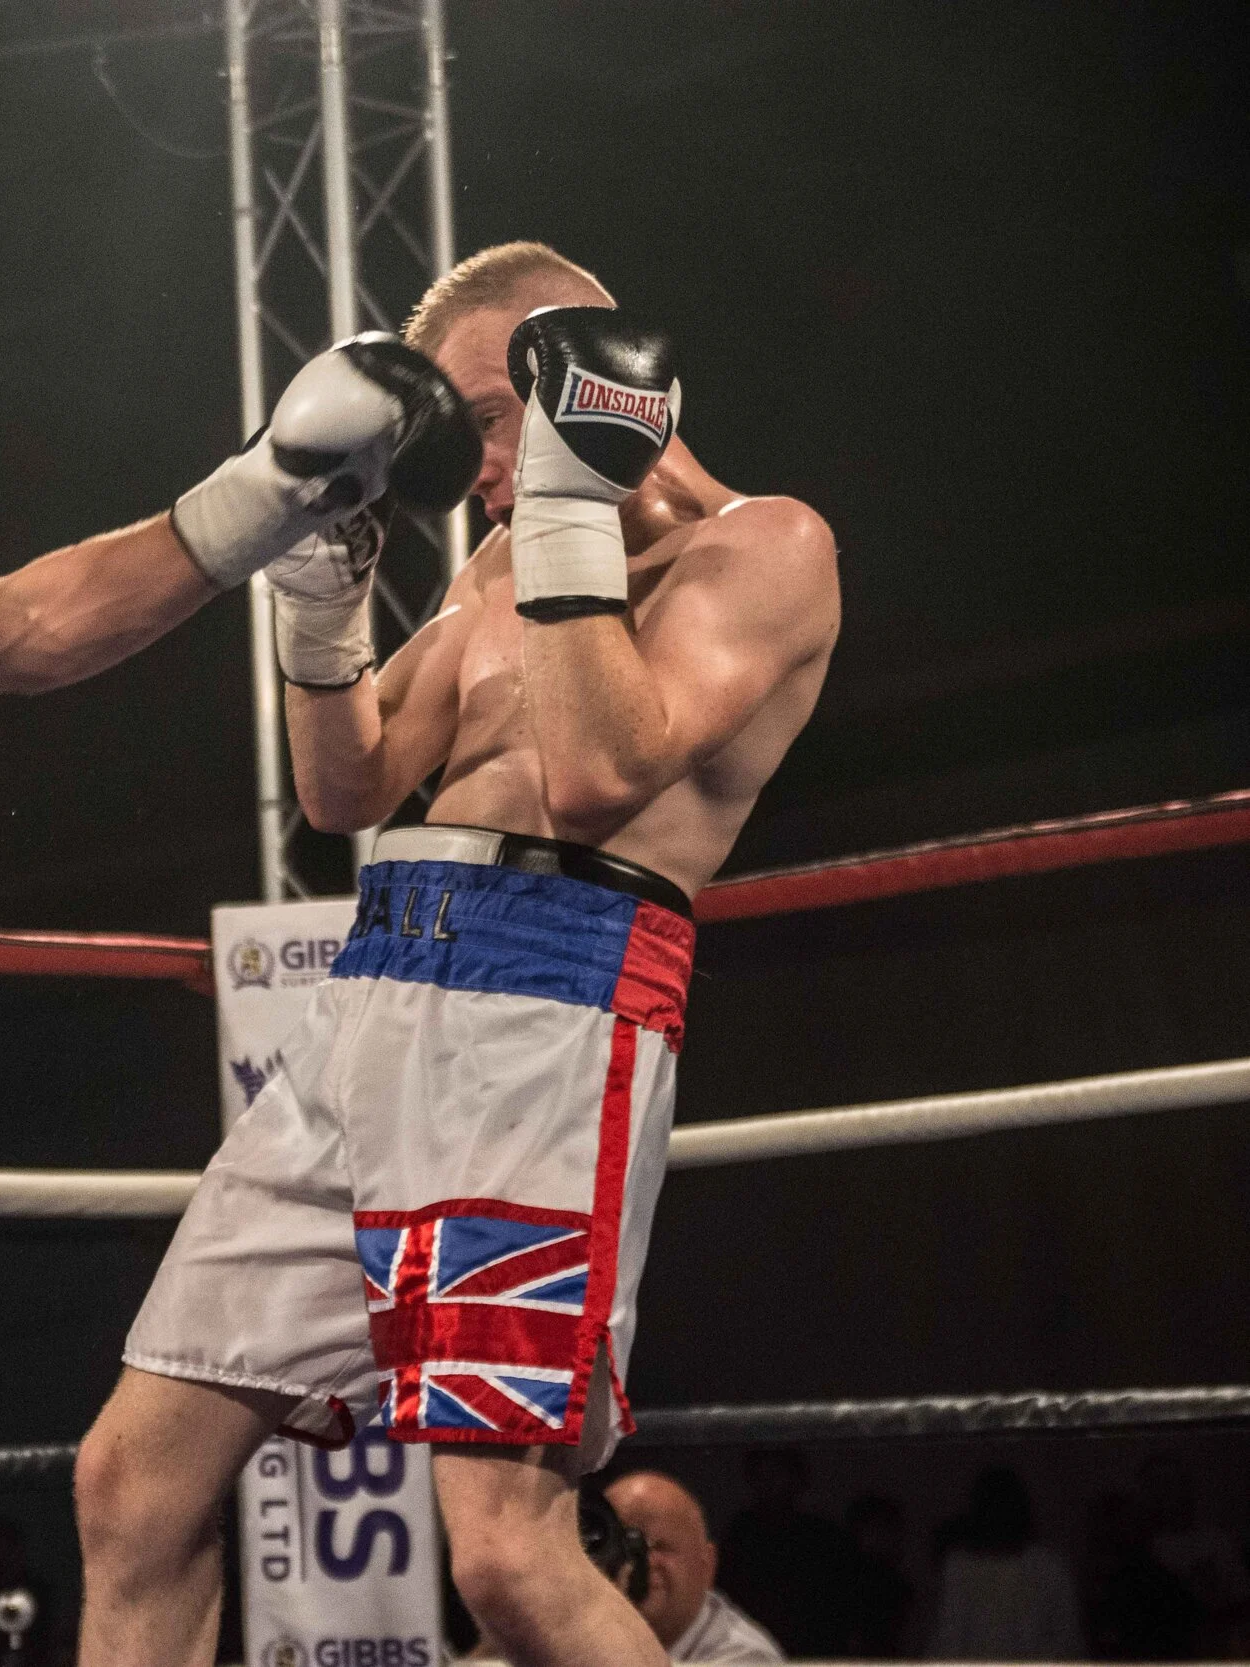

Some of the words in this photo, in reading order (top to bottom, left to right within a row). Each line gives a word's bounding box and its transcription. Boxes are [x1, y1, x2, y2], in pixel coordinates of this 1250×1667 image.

[561, 371, 667, 438] LONSDALE
[261, 1499, 290, 1582] LTD
[314, 1637, 431, 1667] GIBBS
